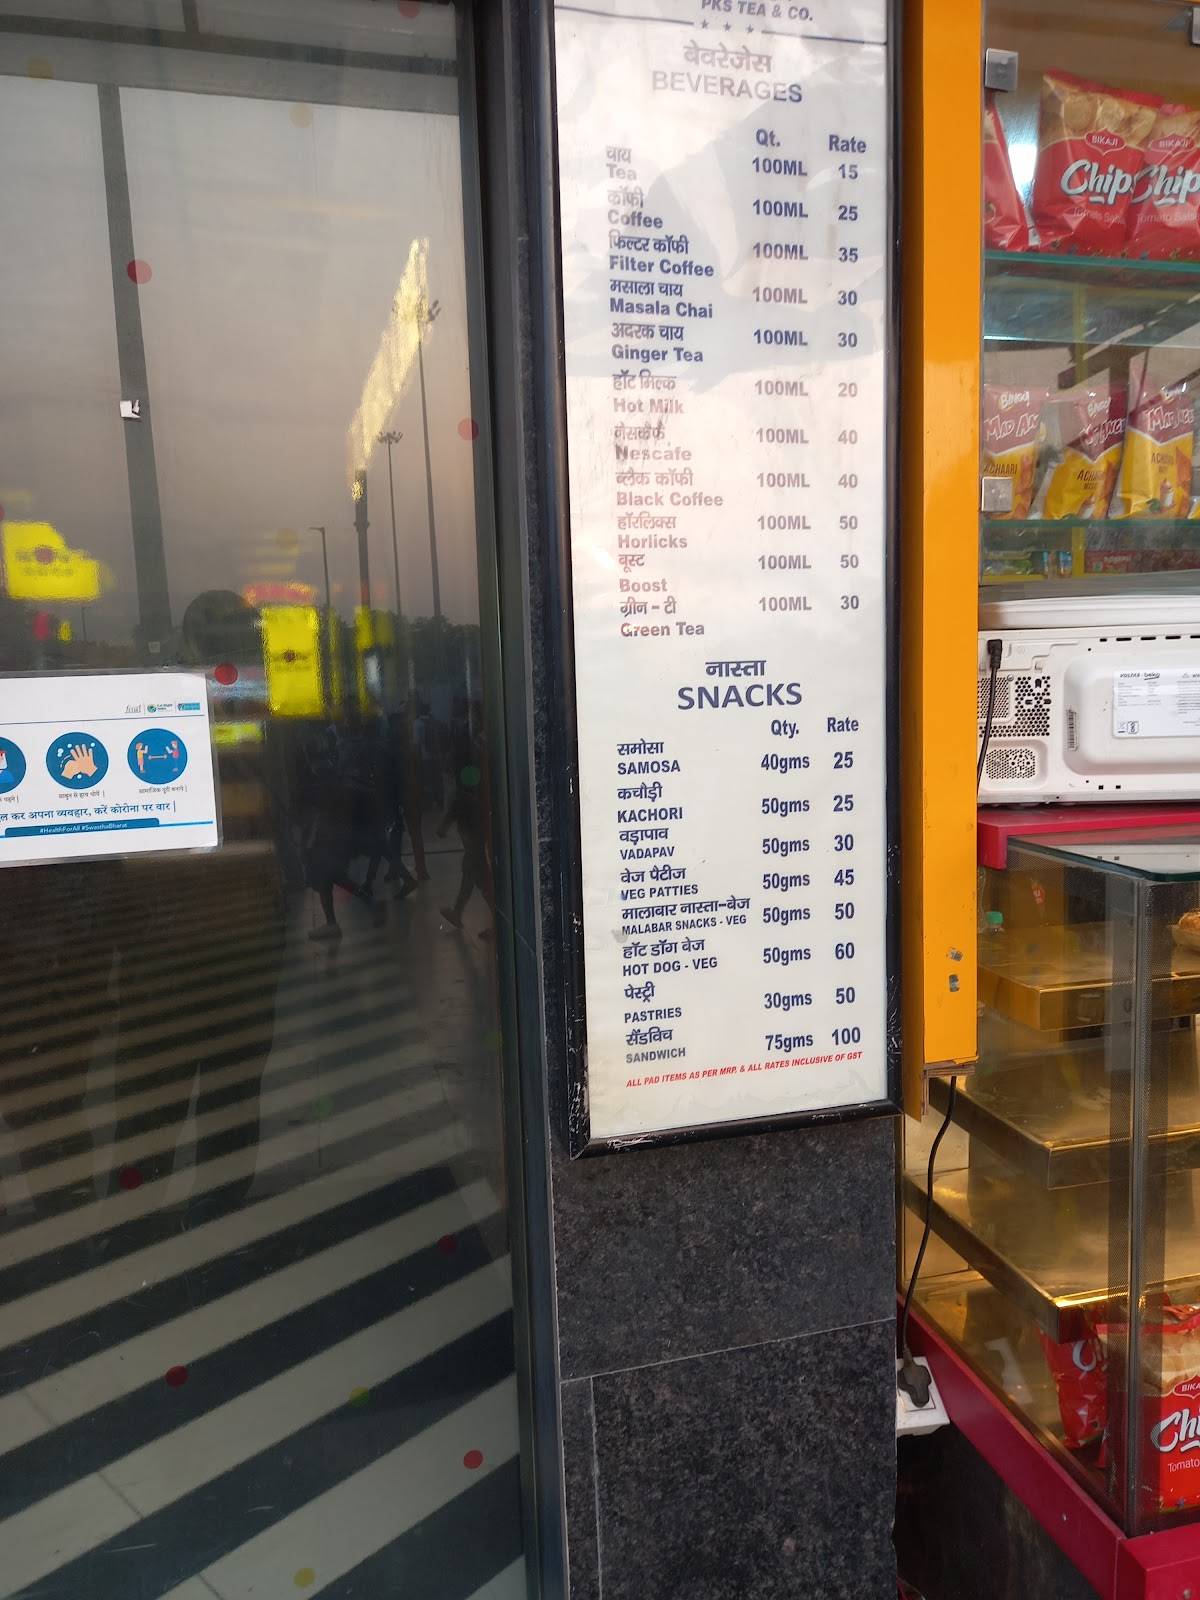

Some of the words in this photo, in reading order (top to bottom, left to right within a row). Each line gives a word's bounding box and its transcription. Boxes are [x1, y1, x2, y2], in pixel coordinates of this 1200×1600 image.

[702, 0, 732, 12] PKS
[738, 1, 766, 16] TEA
[772, 4, 782, 18] &
[788, 6, 814, 21] CO.
[652, 70, 803, 103] BEVERAGES
[756, 128, 781, 148] Qt.
[828, 134, 868, 154] Rate
[1091, 134, 1119, 146] BIKAJI
[1158, 138, 1190, 149] BIKAJI
[606, 146, 632, 164] चाय
[606, 163, 637, 181] Tea
[752, 157, 808, 177] 100ML
[838, 163, 859, 180] 15
[1061, 159, 1134, 205] Chip
[607, 186, 645, 208] कॉफी
[608, 209, 663, 229] Coffee
[753, 199, 808, 218] 100ML
[838, 205, 859, 221] 25
[608, 229, 650, 252] फिल्टर
[652, 234, 689, 254] कॉफी
[752, 242, 809, 261] 100ML
[838, 247, 859, 263] 35
[609, 255, 655, 273] Filter
[659, 259, 715, 278] Coffee
[609, 279, 656, 295] मसाला
[658, 282, 684, 298] चाय
[752, 286, 808, 304] 100ML
[838, 290, 858, 306] 30
[609, 297, 671, 316] Masala
[675, 302, 713, 319] Chai
[611, 322, 656, 340] अदरक
[658, 324, 685, 341] चाय
[753, 329, 808, 346] 100ML
[838, 332, 858, 348] 30
[611, 343, 668, 363] Ginger
[673, 346, 704, 362] Tea
[612, 369, 636, 391] हॉट
[754, 380, 809, 397] 100ML
[838, 382, 858, 397] 20
[613, 397, 644, 414] Hot
[649, 398, 685, 414] Milk
[756, 428, 810, 444] 100ML
[838, 429, 858, 445] 40
[615, 443, 693, 461] Nescafe
[653, 466, 694, 487] कॉफी
[756, 473, 811, 488] 100ML
[838, 473, 858, 489] 40
[616, 491, 665, 507] Black
[669, 491, 724, 507] Coffee
[757, 515, 811, 530] 100ML
[839, 515, 858, 530] 50
[617, 533, 689, 549] Horlicks
[758, 555, 812, 570] 100ML
[840, 554, 859, 569] 50
[619, 578, 668, 593] Boost
[619, 595, 648, 618] ग्रीन
[664, 595, 677, 615] टी
[758, 597, 812, 612] 100ML
[840, 595, 860, 610] 30
[620, 622, 671, 637] Green
[675, 621, 705, 636] Tea
[705, 659, 767, 678] नास्ता
[677, 682, 803, 710] SNACKS
[770, 718, 800, 739] Qty.
[827, 717, 860, 733] Rate
[616, 738, 665, 756] समोसा
[617, 759, 681, 775] SAMOSA
[761, 753, 810, 774] 40gms
[833, 751, 854, 769] 25
[11, 811, 26, 821] कर
[29, 809, 54, 819] अपना
[94, 804, 108, 816] करें
[110, 803, 139, 814] कोरोना
[142, 803, 154, 812] पर
[155, 802, 171, 811] वार
[617, 807, 683, 823] KACHORI
[761, 797, 810, 818] 50gms
[833, 794, 854, 812] 25
[39, 825, 80, 835] #HealthForAll
[619, 846, 675, 861] VADAPAV
[762, 838, 810, 858] 50gms
[834, 833, 855, 852] 30
[620, 868, 646, 884] वेज
[762, 872, 811, 893] 50gms
[834, 868, 855, 887] 45
[621, 888, 646, 901] VEG
[649, 884, 699, 899] PATTIES
[762, 905, 811, 927] 50gms
[834, 901, 855, 921] 50
[621, 921, 673, 937] MALABAR
[675, 917, 717, 931] SNACKS
[725, 914, 747, 926] VEG
[622, 941, 649, 960] हॉट
[650, 938, 678, 957] डॉग
[681, 936, 706, 953] वेज
[763, 946, 812, 967] 50gms
[834, 942, 855, 960] 60
[622, 963, 649, 977] HOT
[653, 960, 681, 974] DOG
[692, 956, 718, 970] VEG
[624, 981, 655, 1002] पेस्ट्री
[764, 991, 813, 1012] 30gms
[835, 986, 856, 1005] 50
[624, 1007, 682, 1024] PASTRIES
[765, 1034, 814, 1053] 75gms
[831, 1026, 861, 1045] 100
[625, 1047, 687, 1064] SANDWICH
[626, 1078, 642, 1088] ALL
[644, 1075, 660, 1086] PAD
[662, 1072, 687, 1083] ITEMS
[689, 1070, 700, 1080] AS
[702, 1068, 718, 1079] PER
[740, 1064, 746, 1073] &
[748, 1062, 763, 1072] ALL
[764, 1059, 790, 1070] RATES
[791, 1054, 833, 1067] INCLUSIVE
[835, 1052, 847, 1061] OF
[847, 1051, 863, 1060] GST
[1167, 1459, 1200, 1473] Tomato
